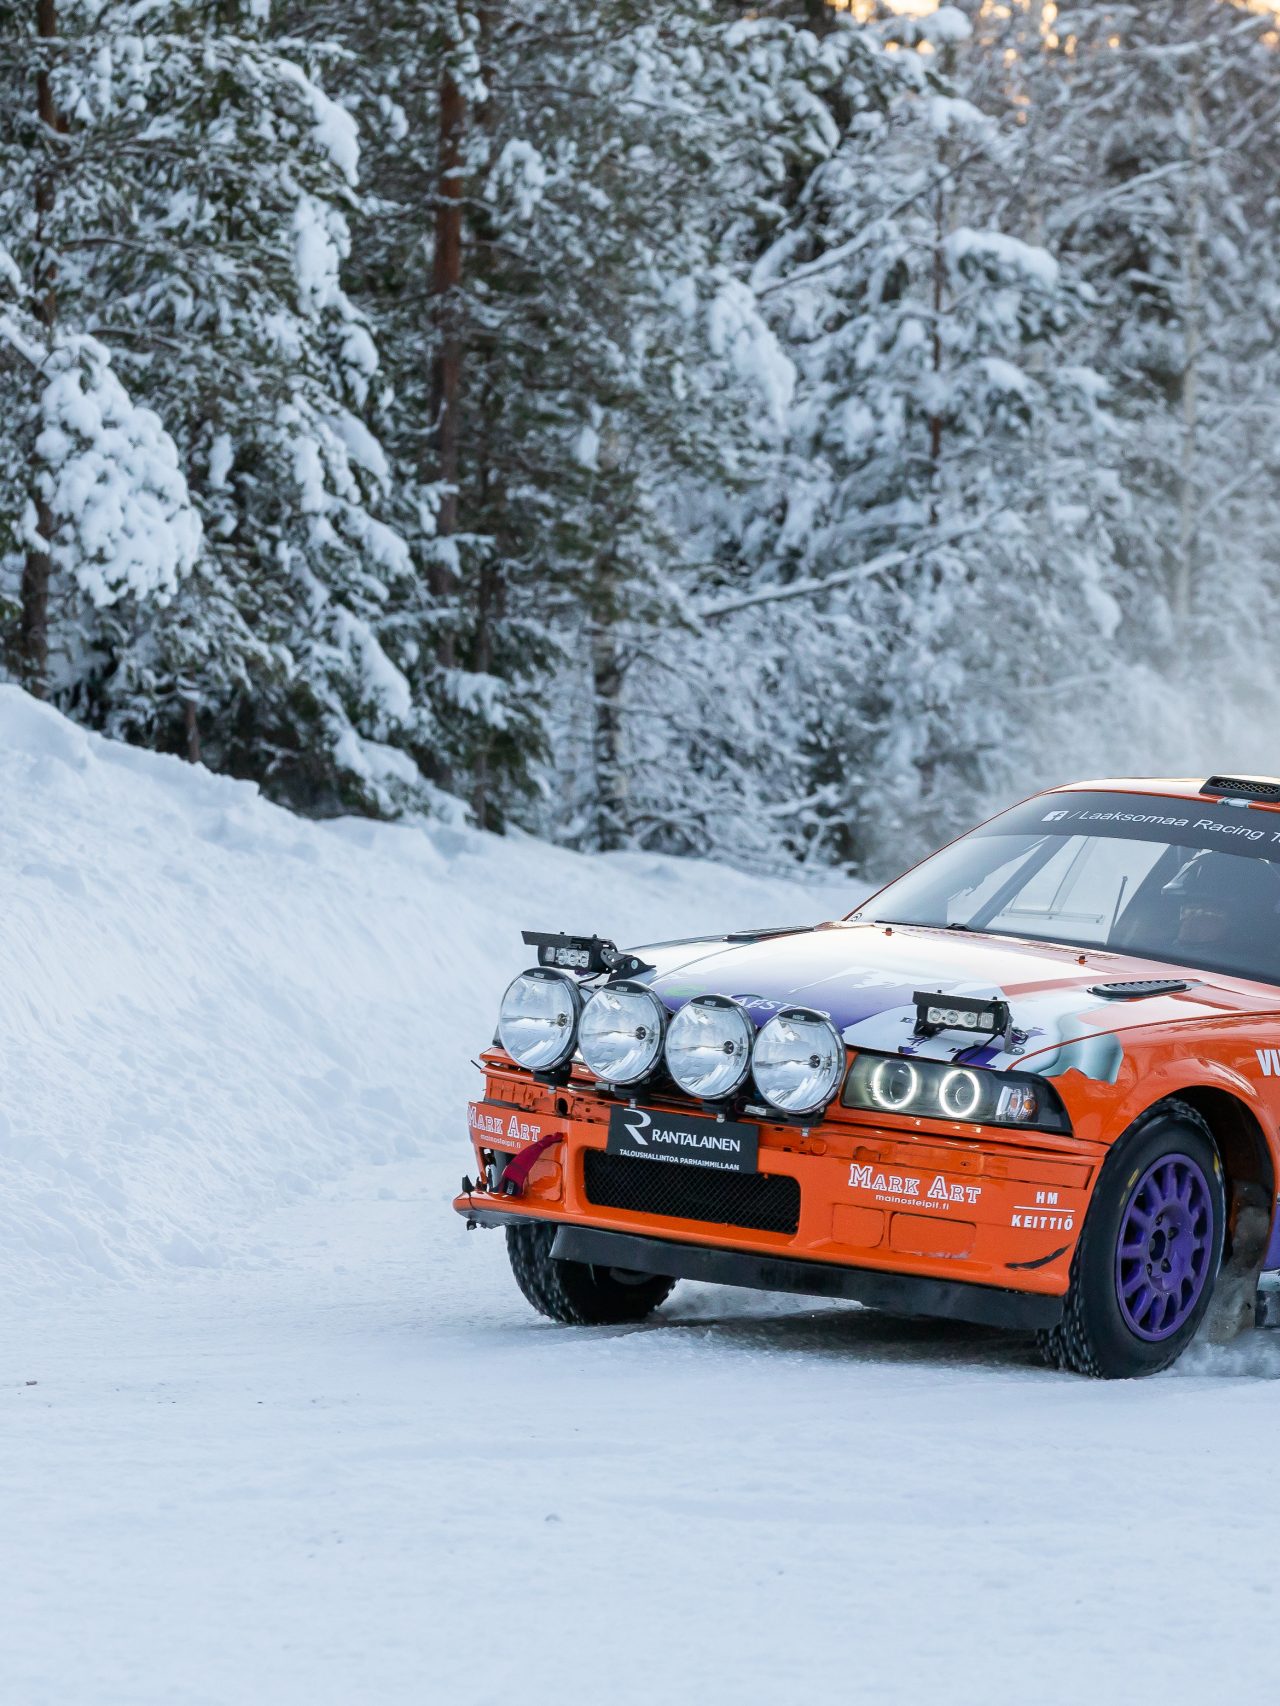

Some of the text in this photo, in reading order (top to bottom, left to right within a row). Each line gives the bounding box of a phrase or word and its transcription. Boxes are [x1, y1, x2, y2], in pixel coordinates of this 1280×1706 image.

[1079, 810, 1188, 827] Laaksomaa
[1193, 819, 1266, 840] Racing
[507, 1115, 541, 1142] ART
[652, 1129, 741, 1152] RANTALAINEN
[619, 1149, 740, 1171] TALOUSHALLINTOA PARHAIMMILLAAN
[848, 1163, 981, 1204] MARK ART
[875, 1194, 949, 1210] mainosteipit.fi
[1036, 1191, 1058, 1205] HM
[1011, 1214, 1074, 1231] KEITTIÖ
